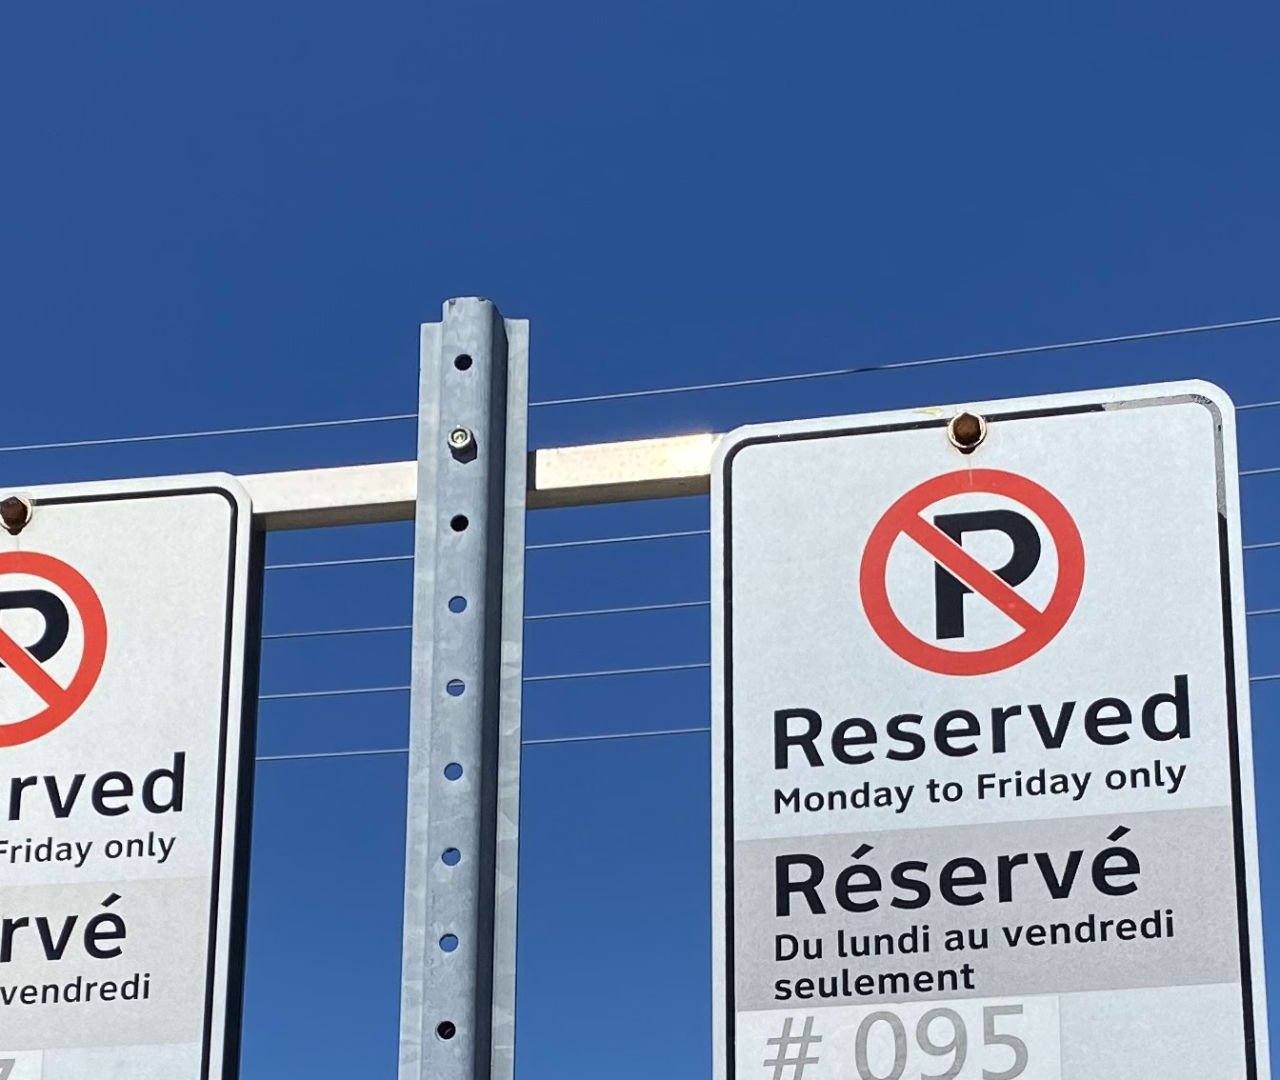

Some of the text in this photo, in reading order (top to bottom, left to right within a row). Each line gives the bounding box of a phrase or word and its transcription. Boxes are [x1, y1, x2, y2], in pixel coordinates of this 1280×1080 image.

[775, 674, 1191, 770] Reserved
[775, 760, 1186, 814] Monday to Friday only
[105, 832, 175, 863] only
[775, 826, 1140, 917] Réservé
[776, 910, 1174, 961] Du lundi au vendredi
[0, 974, 149, 1005] vendredi
[775, 964, 975, 1000] seulement
